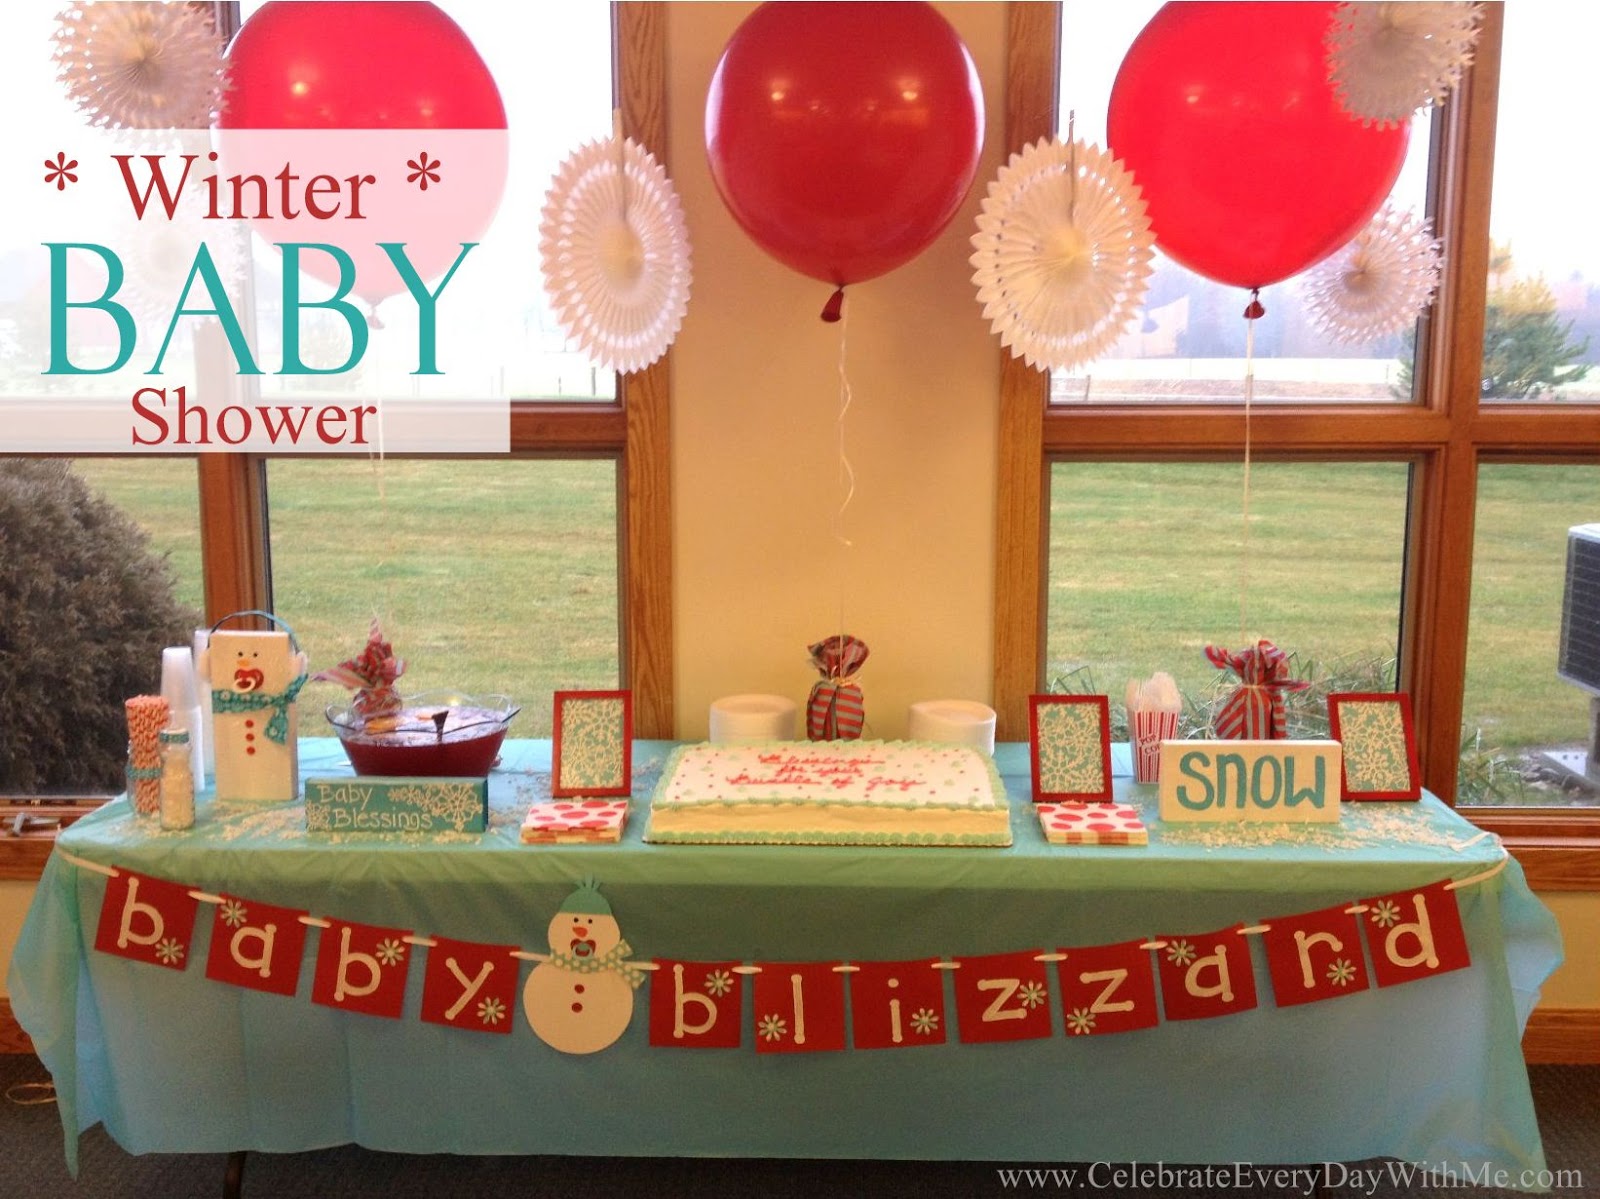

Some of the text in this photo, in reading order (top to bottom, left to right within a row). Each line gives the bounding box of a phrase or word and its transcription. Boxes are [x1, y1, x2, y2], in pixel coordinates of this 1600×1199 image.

[316, 784, 373, 810] Baby
[332, 807, 433, 830] Blessings
[117, 877, 1441, 1045] baby blizzard
